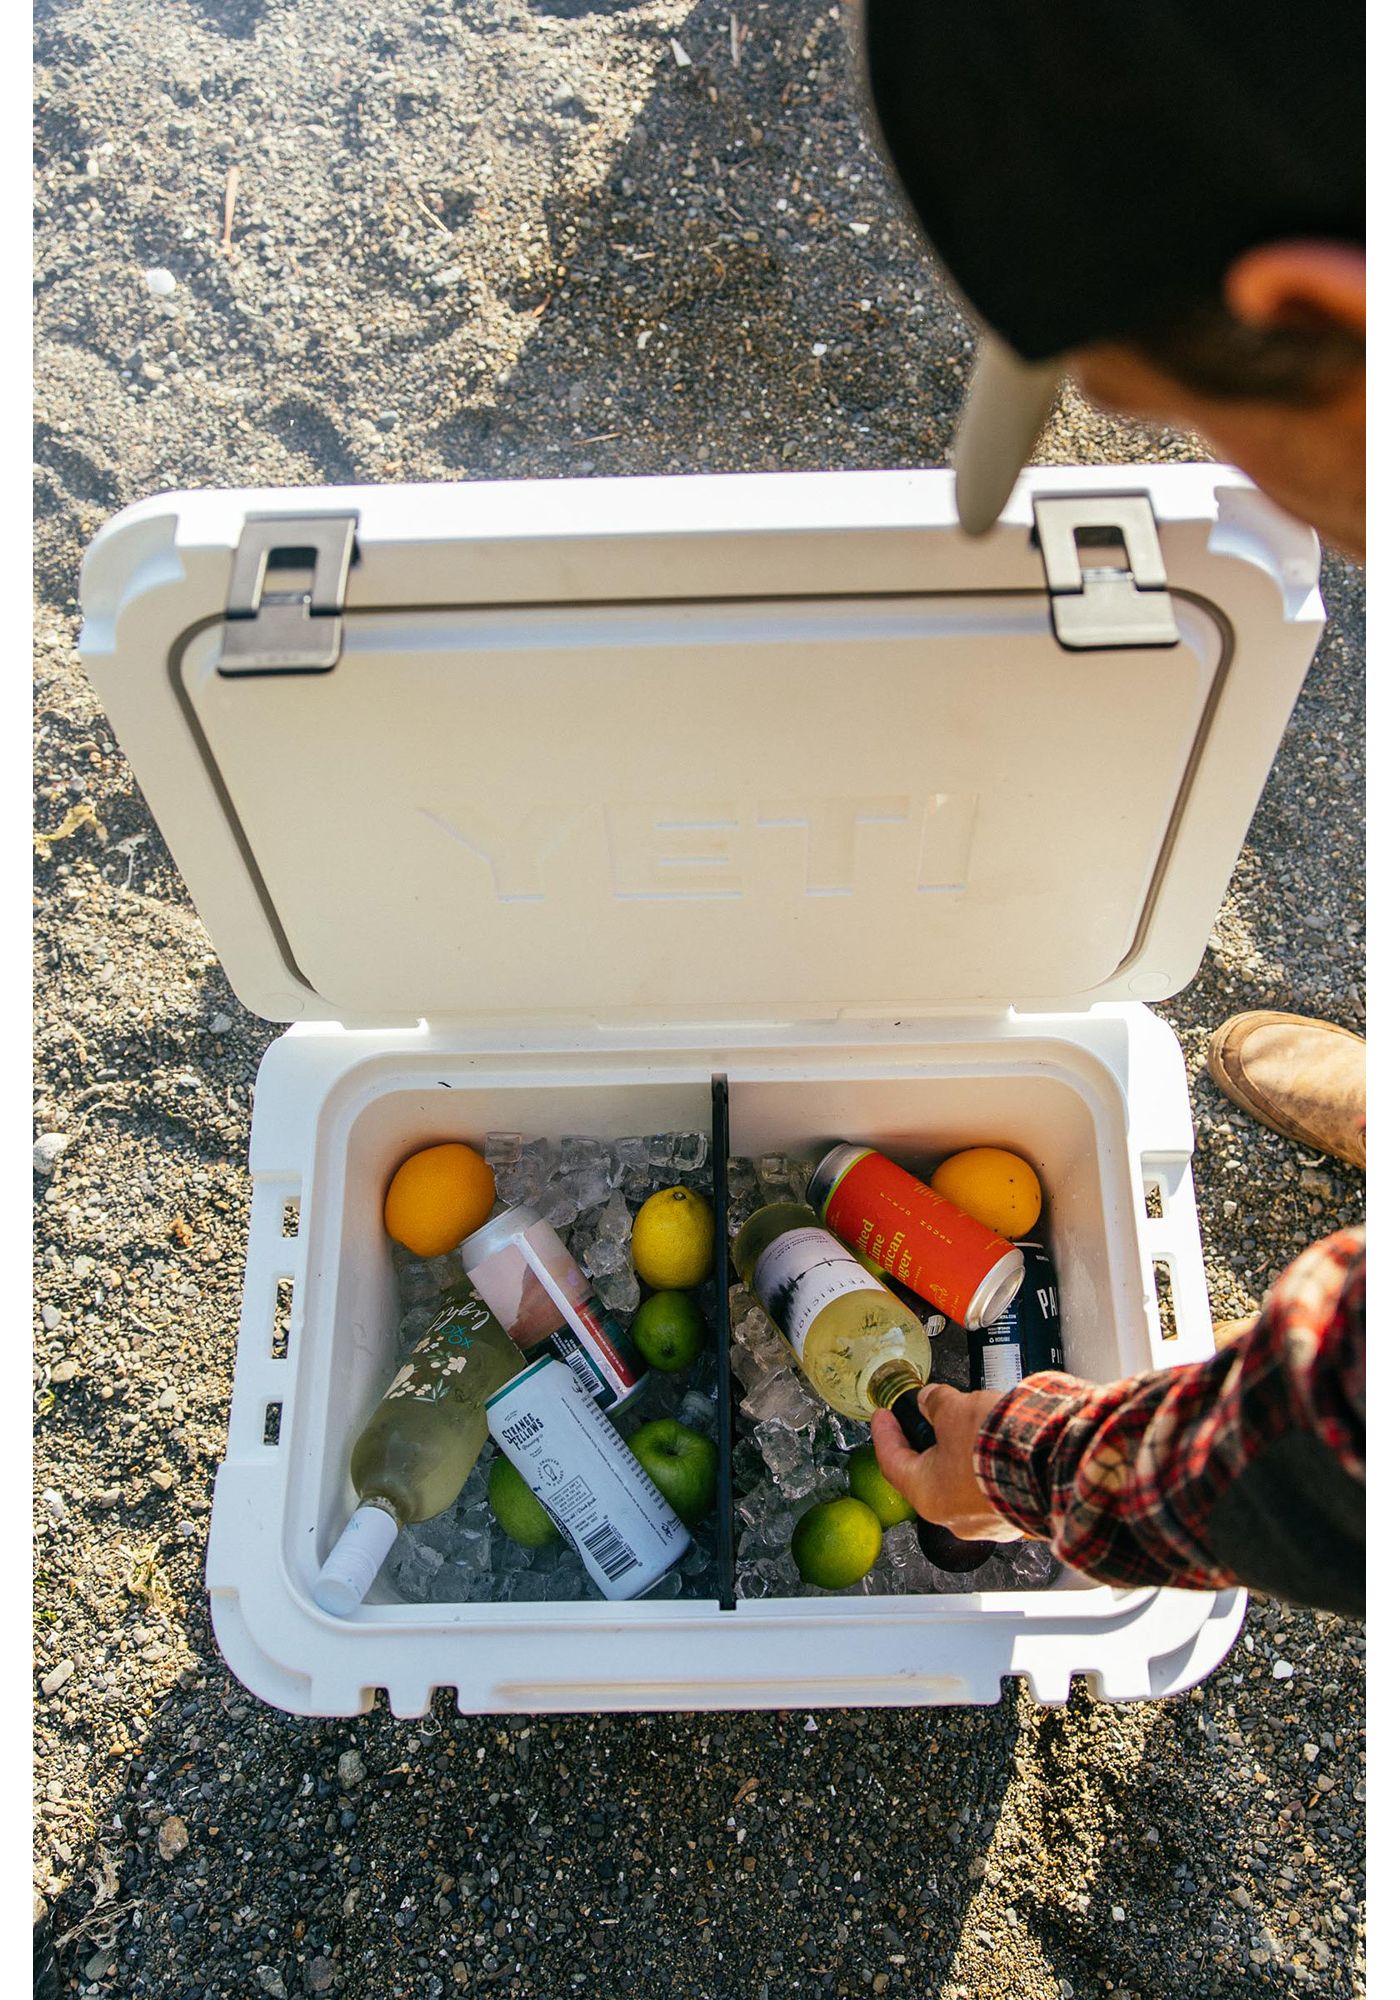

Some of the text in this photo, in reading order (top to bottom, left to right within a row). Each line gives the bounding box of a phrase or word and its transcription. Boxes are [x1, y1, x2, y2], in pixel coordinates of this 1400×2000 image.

[413, 794, 981, 903] YETI
[868, 1234, 885, 1262] ime
[920, 1220, 953, 1245] HOUSE
[795, 1279, 866, 1339] PETRICHOR
[502, 1412, 536, 1444] STRANGE
[512, 1418, 545, 1450] FELLOWS
